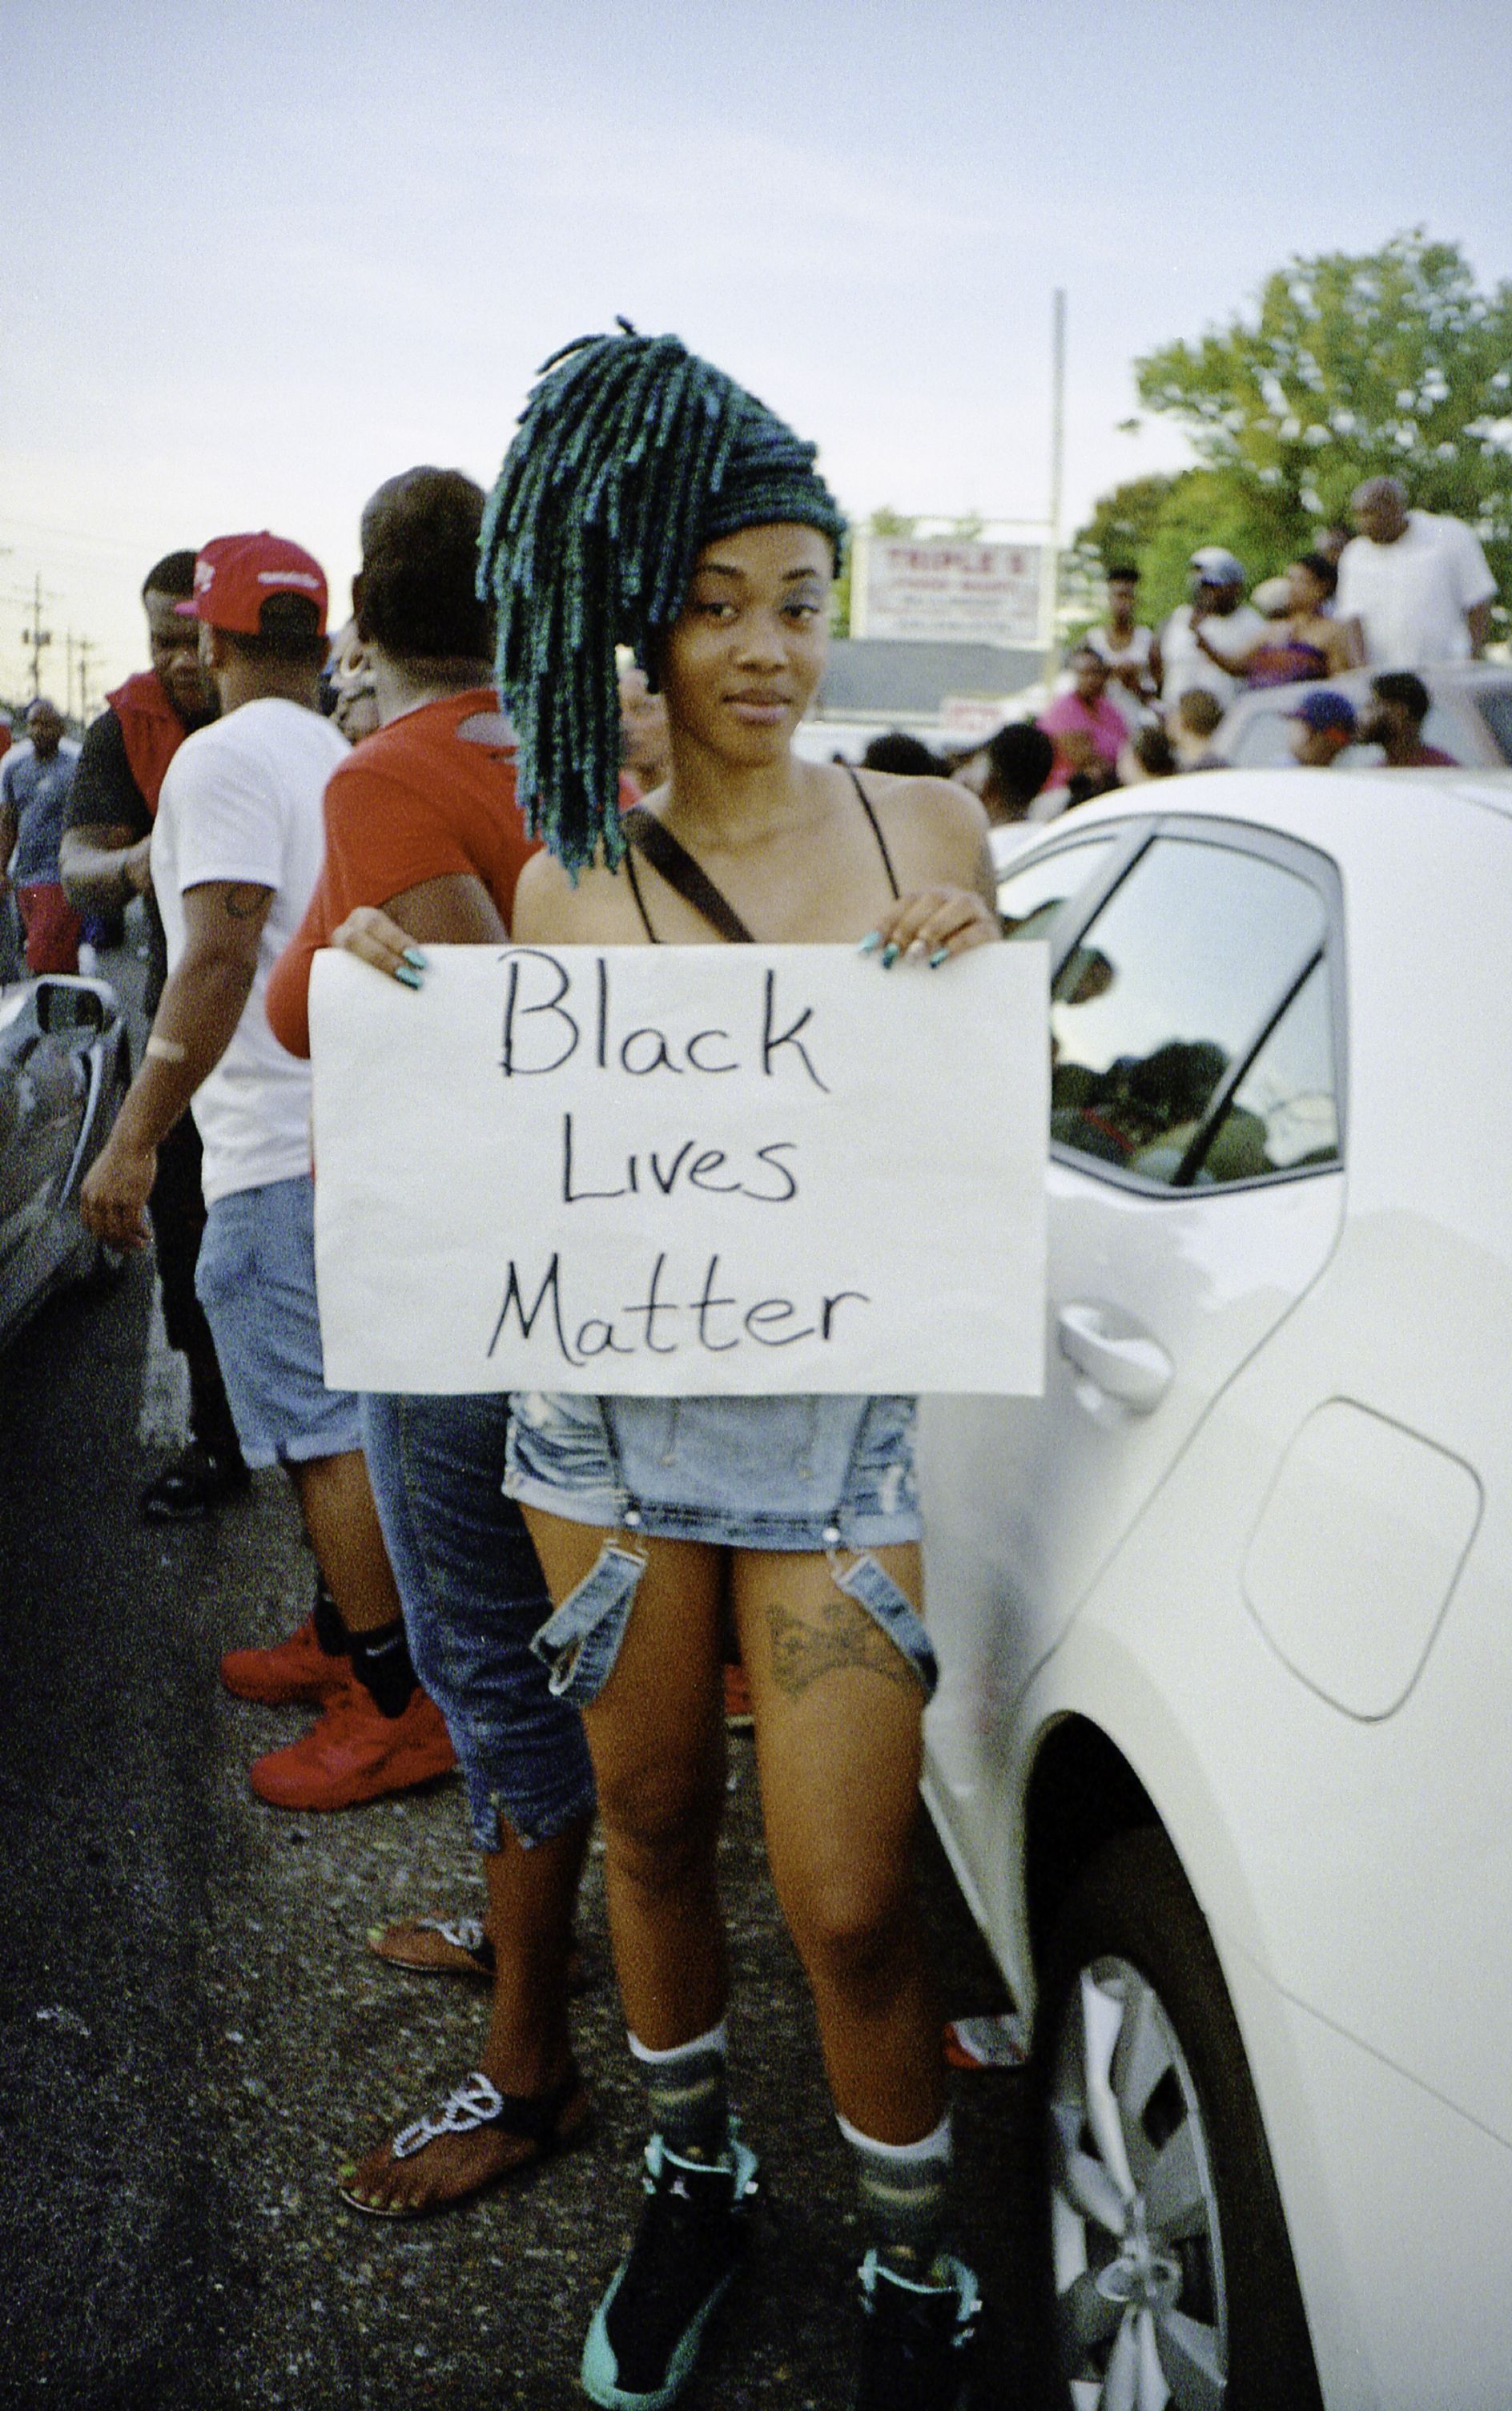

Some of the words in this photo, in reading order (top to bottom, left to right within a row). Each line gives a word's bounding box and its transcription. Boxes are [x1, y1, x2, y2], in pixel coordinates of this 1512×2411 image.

[497, 949, 830, 1093] Black
[562, 1113, 798, 1205] Lives
[487, 1253, 871, 1367] Matter
